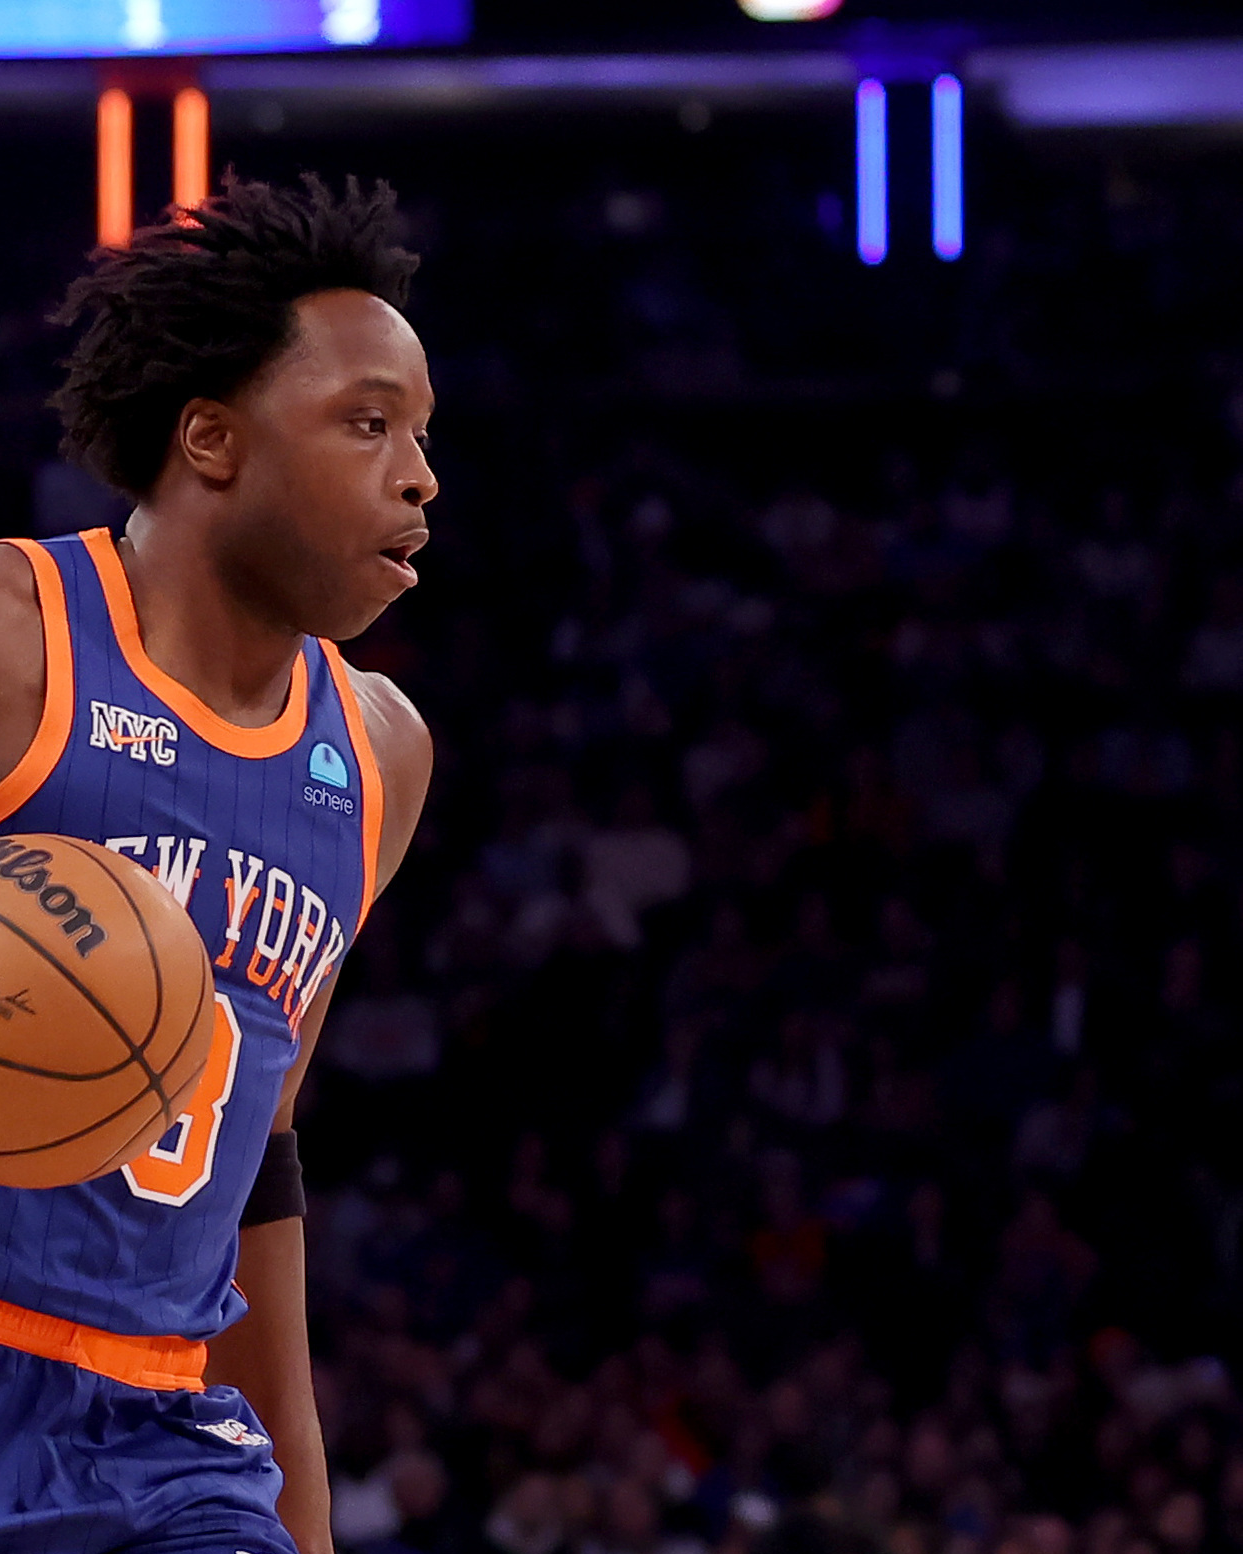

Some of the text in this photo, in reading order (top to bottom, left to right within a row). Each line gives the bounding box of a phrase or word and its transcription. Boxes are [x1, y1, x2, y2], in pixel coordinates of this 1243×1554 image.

[89, 700, 179, 767] NYC
[303, 786, 354, 815] sphere
[227, 848, 345, 1019] YORK
